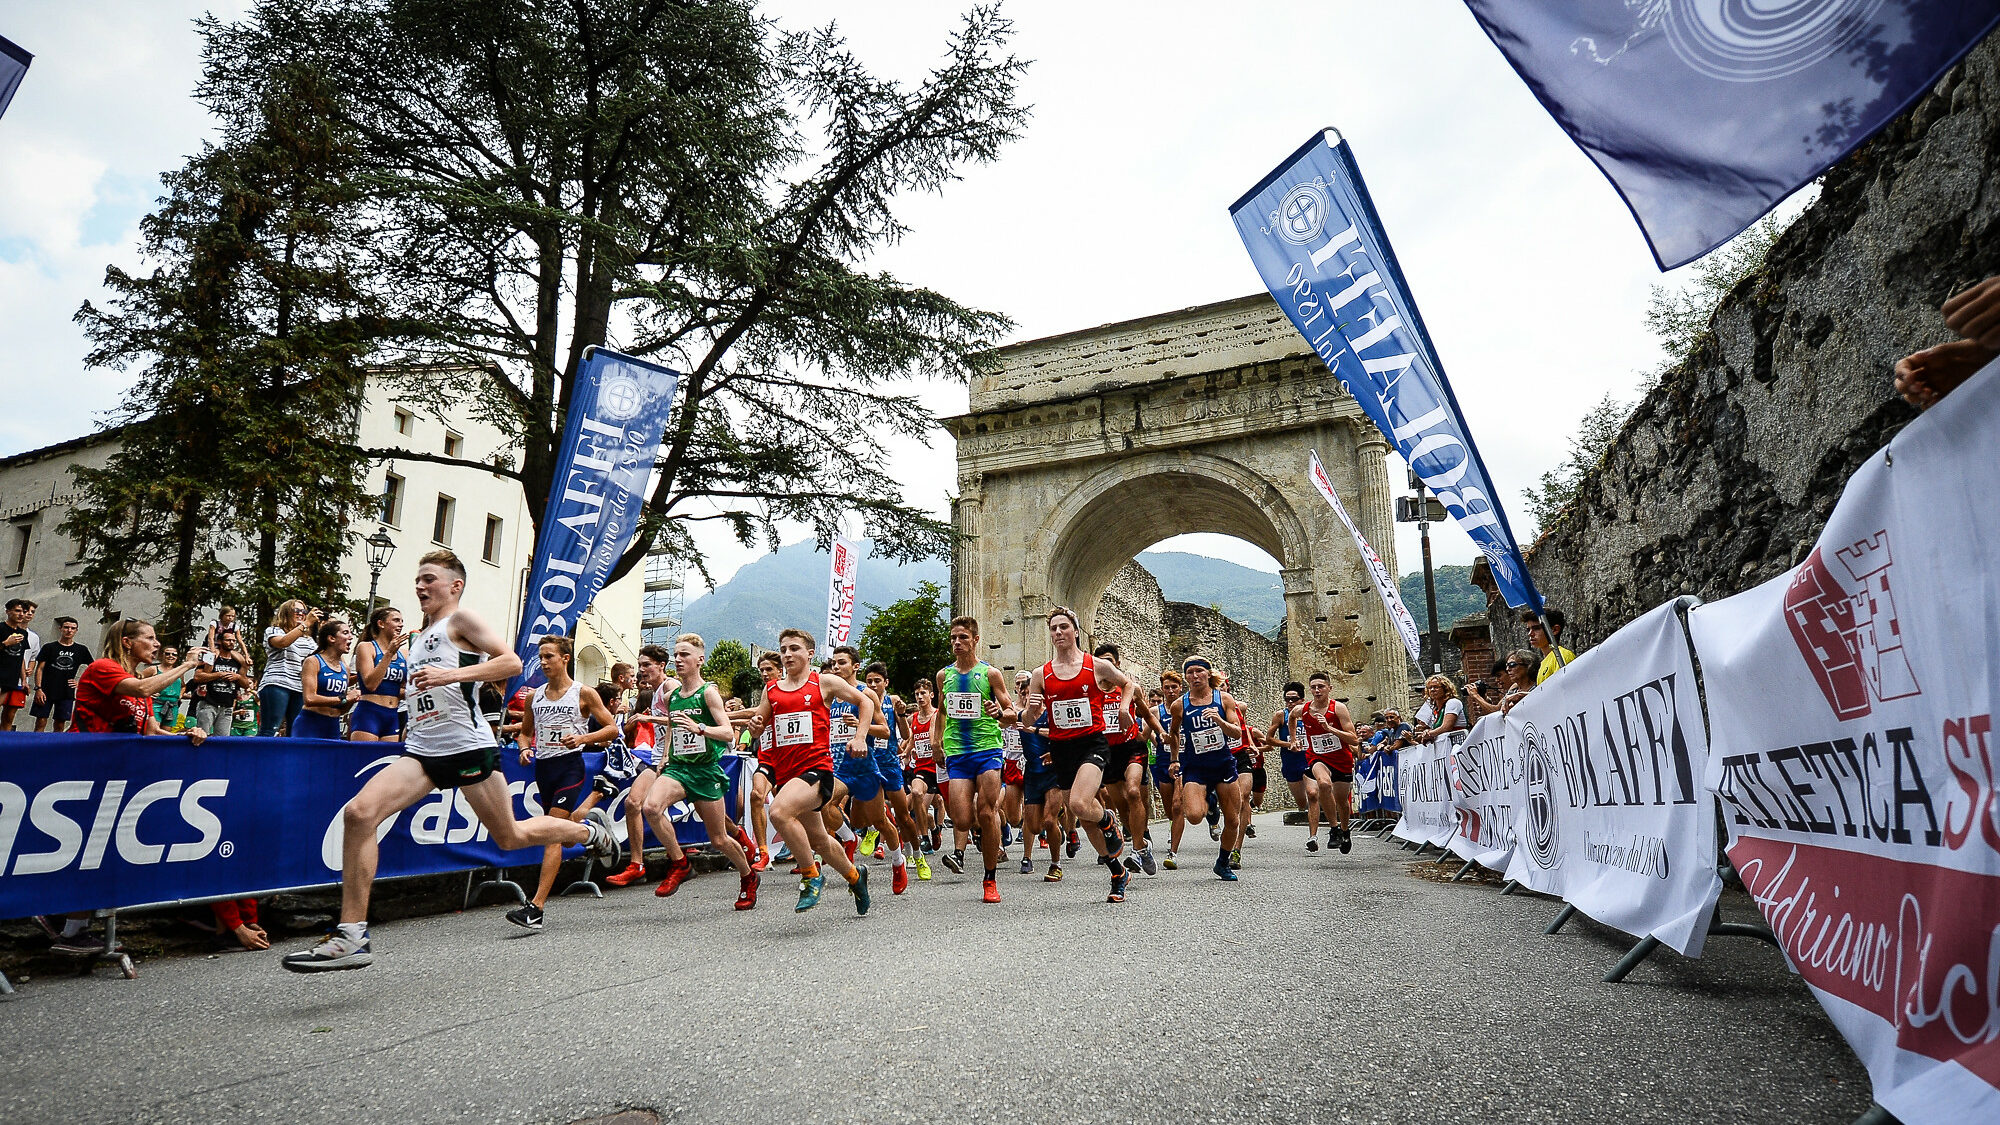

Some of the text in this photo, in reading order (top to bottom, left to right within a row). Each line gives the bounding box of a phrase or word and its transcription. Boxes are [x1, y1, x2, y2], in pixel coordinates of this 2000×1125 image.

[619, 430, 646, 478] 1890
[611, 481, 631, 517] dal
[527, 413, 626, 650] BOLAFFI
[383, 667, 404, 681] USA
[326, 678, 348, 693] USA
[416, 694, 435, 713] 46
[958, 699, 973, 710] 66
[1066, 706, 1082, 719] 88
[787, 720, 801, 734] 87
[1108, 716, 1119, 725] 72
[837, 724, 849, 735] 38
[550, 731, 562, 742] 21
[682, 733, 697, 745] 32
[1204, 734, 1218, 745] 79
[1321, 737, 1334, 747] 86
[1718, 727, 1942, 847] ATLETICA
